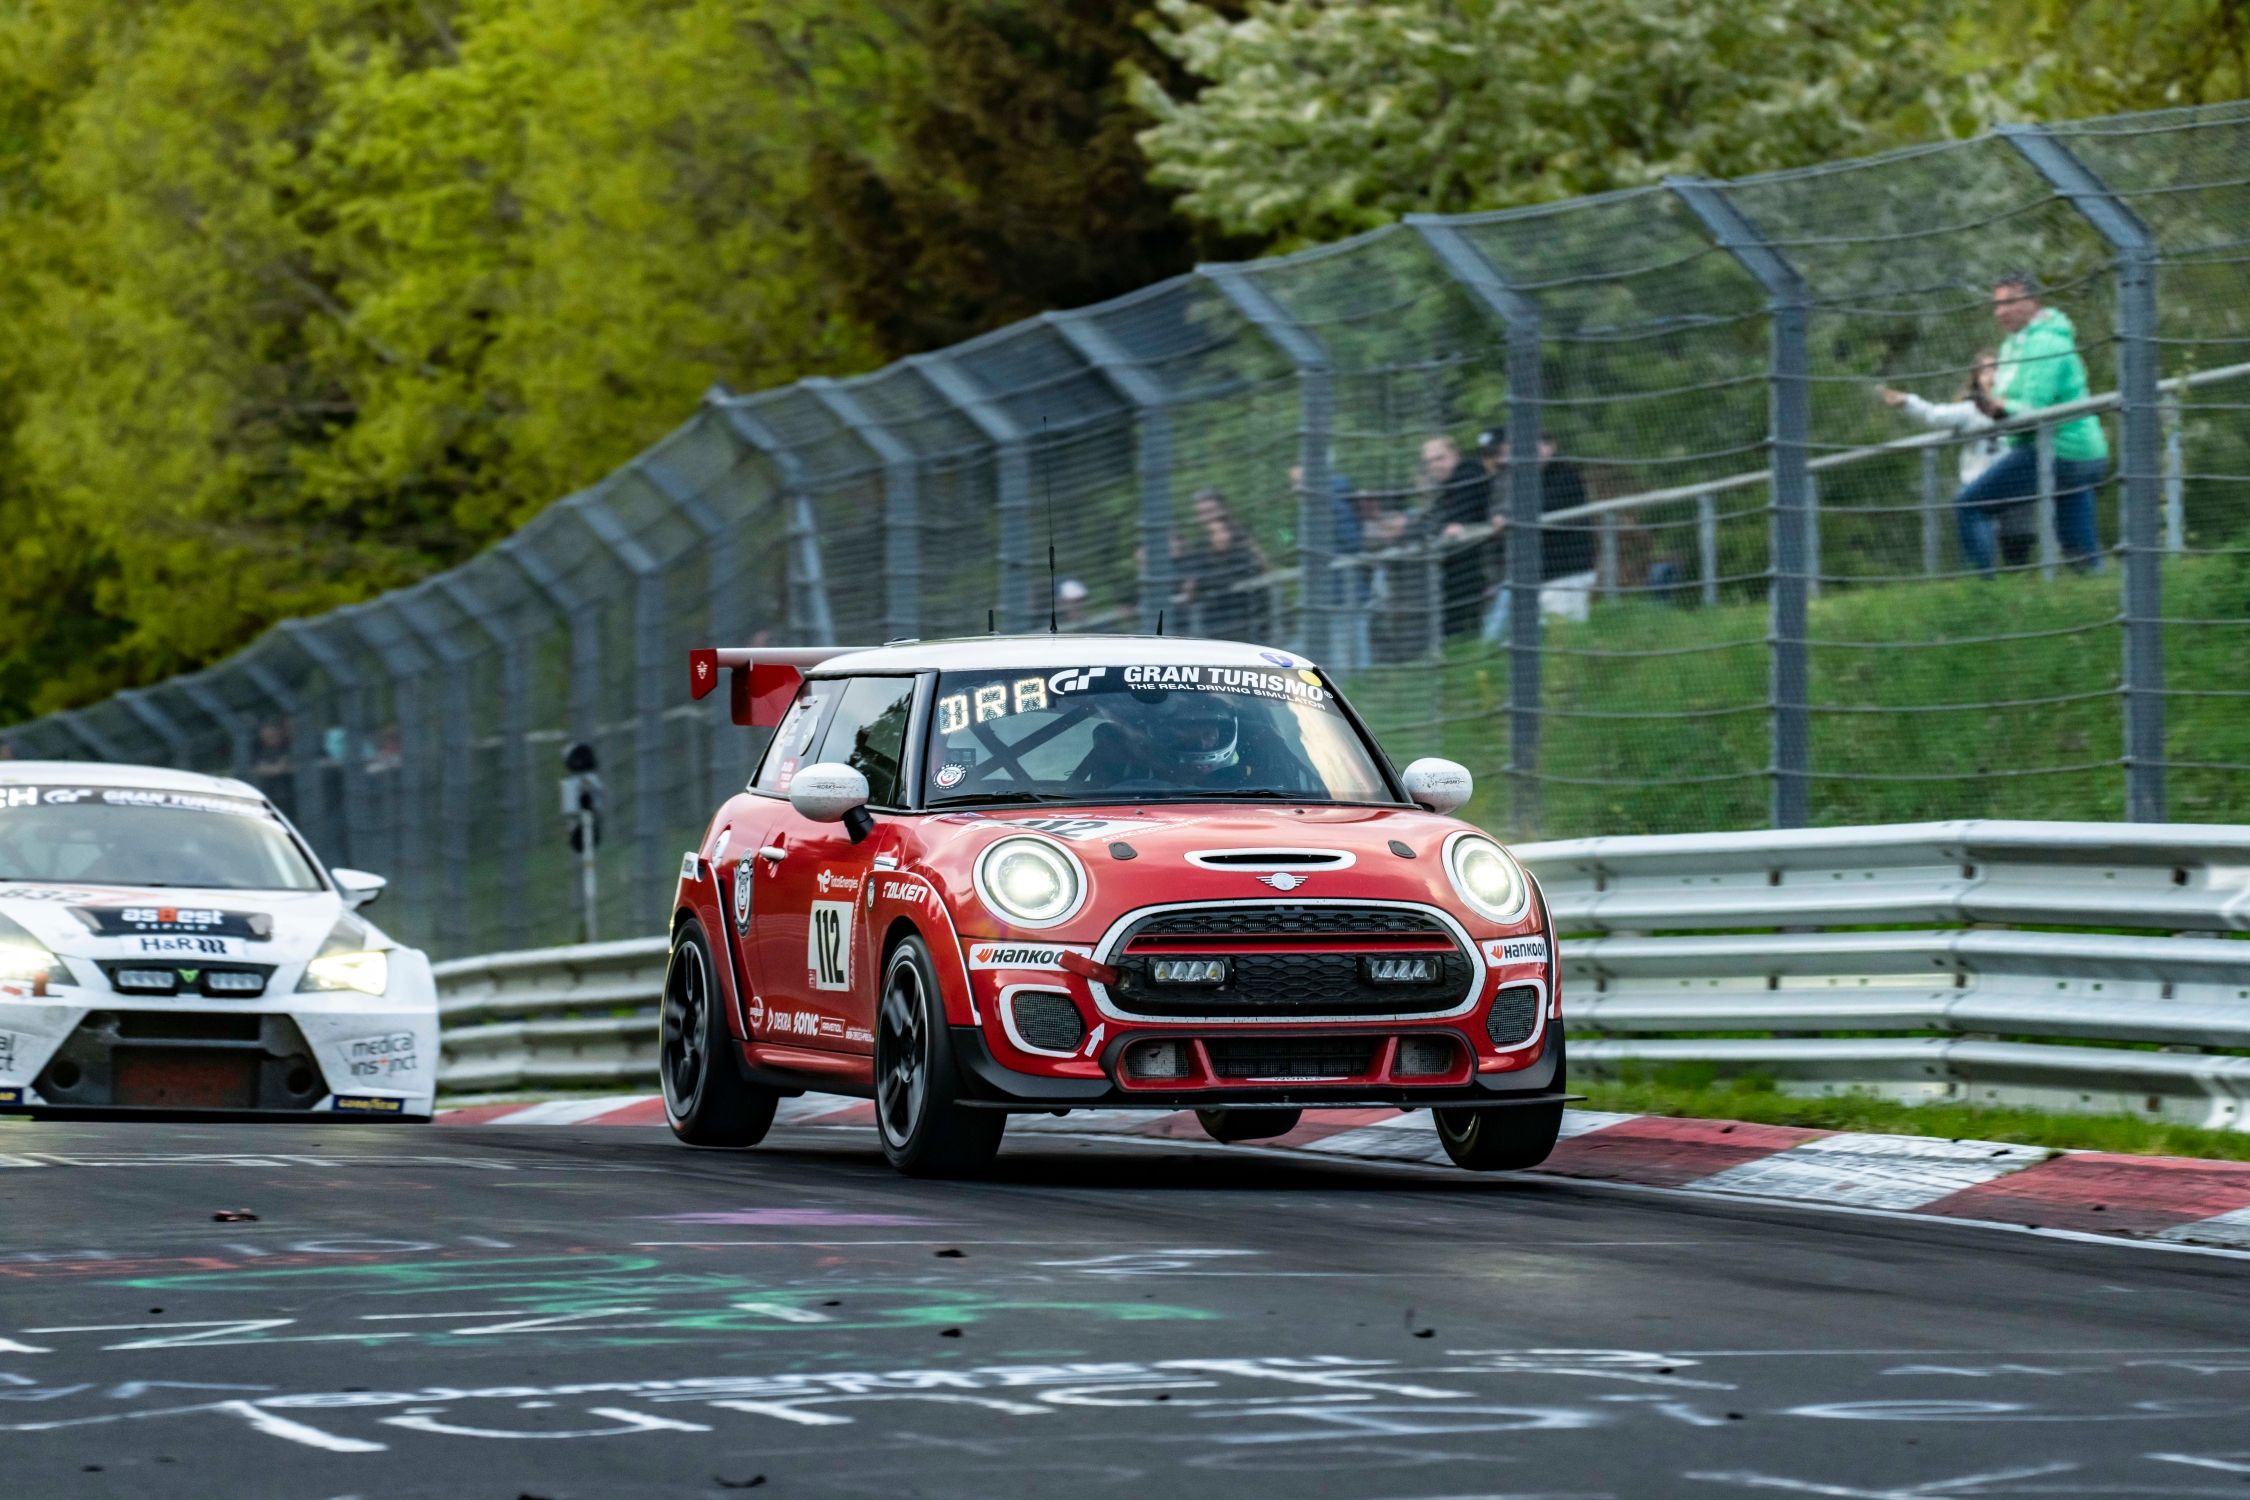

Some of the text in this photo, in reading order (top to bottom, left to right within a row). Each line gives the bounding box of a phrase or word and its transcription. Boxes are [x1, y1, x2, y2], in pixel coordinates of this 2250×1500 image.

[1123, 666, 1199, 683] GRAN
[1208, 668, 1323, 702] TURISMO
[1159, 683, 1194, 691] REAL
[1197, 684, 1250, 695] DRIVING
[1253, 689, 1326, 711] SIMULATOR
[882, 881, 929, 904] FALKEN
[141, 938, 193, 952] H&R
[815, 908, 845, 984] 112
[793, 1011, 819, 1037] SONIC
[352, 1032, 414, 1057] medical
